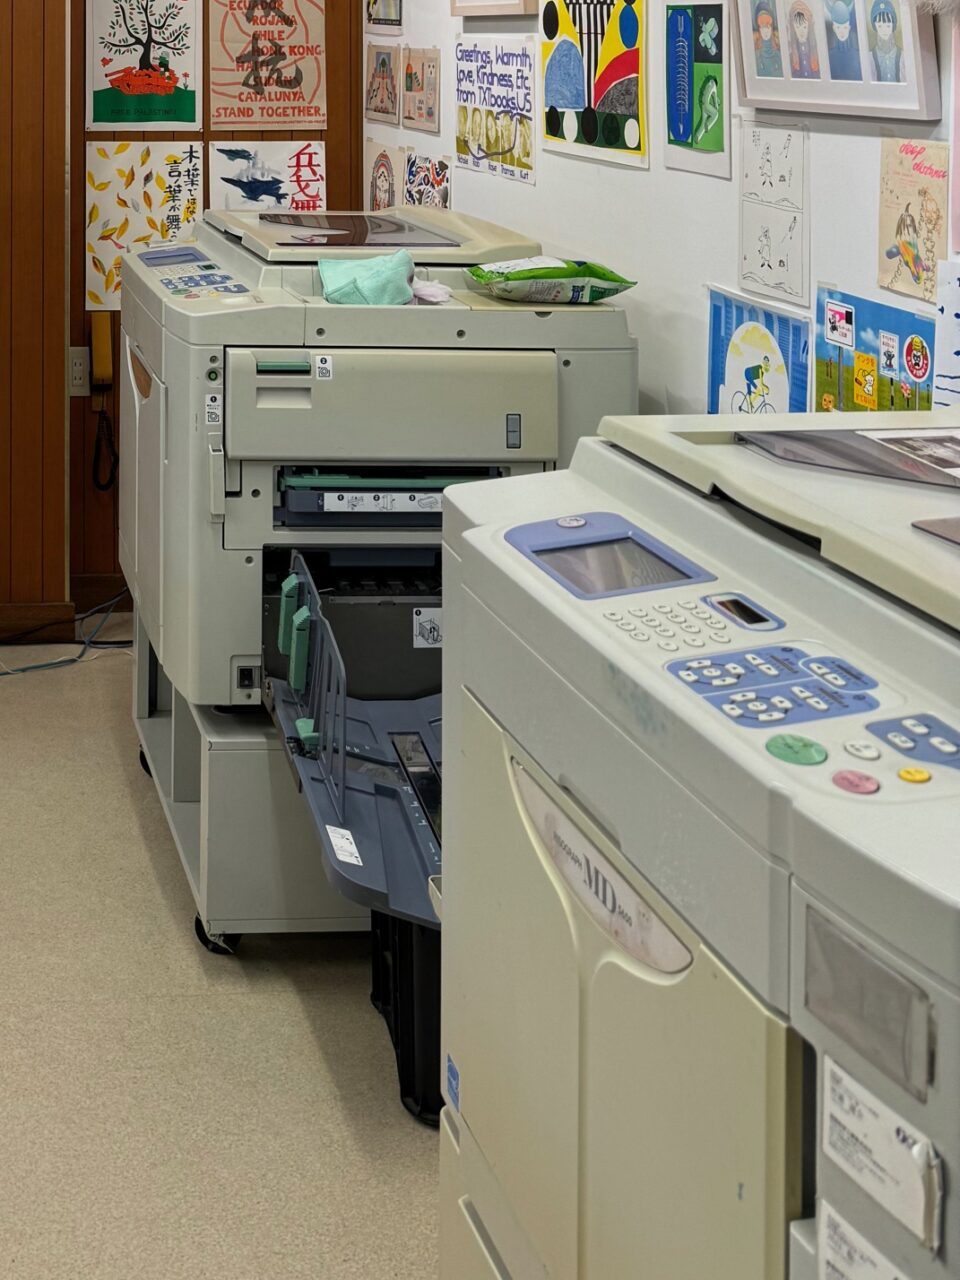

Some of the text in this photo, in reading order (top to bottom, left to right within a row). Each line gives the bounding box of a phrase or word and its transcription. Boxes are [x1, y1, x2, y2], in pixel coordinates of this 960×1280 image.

[228, 0, 284, 11] ECUADOR
[455, 42, 532, 73] Greetings, Warmth,
[237, 90, 306, 103] CATALUNYA
[456, 86, 476, 104] from
[583, 852, 617, 915] MD
